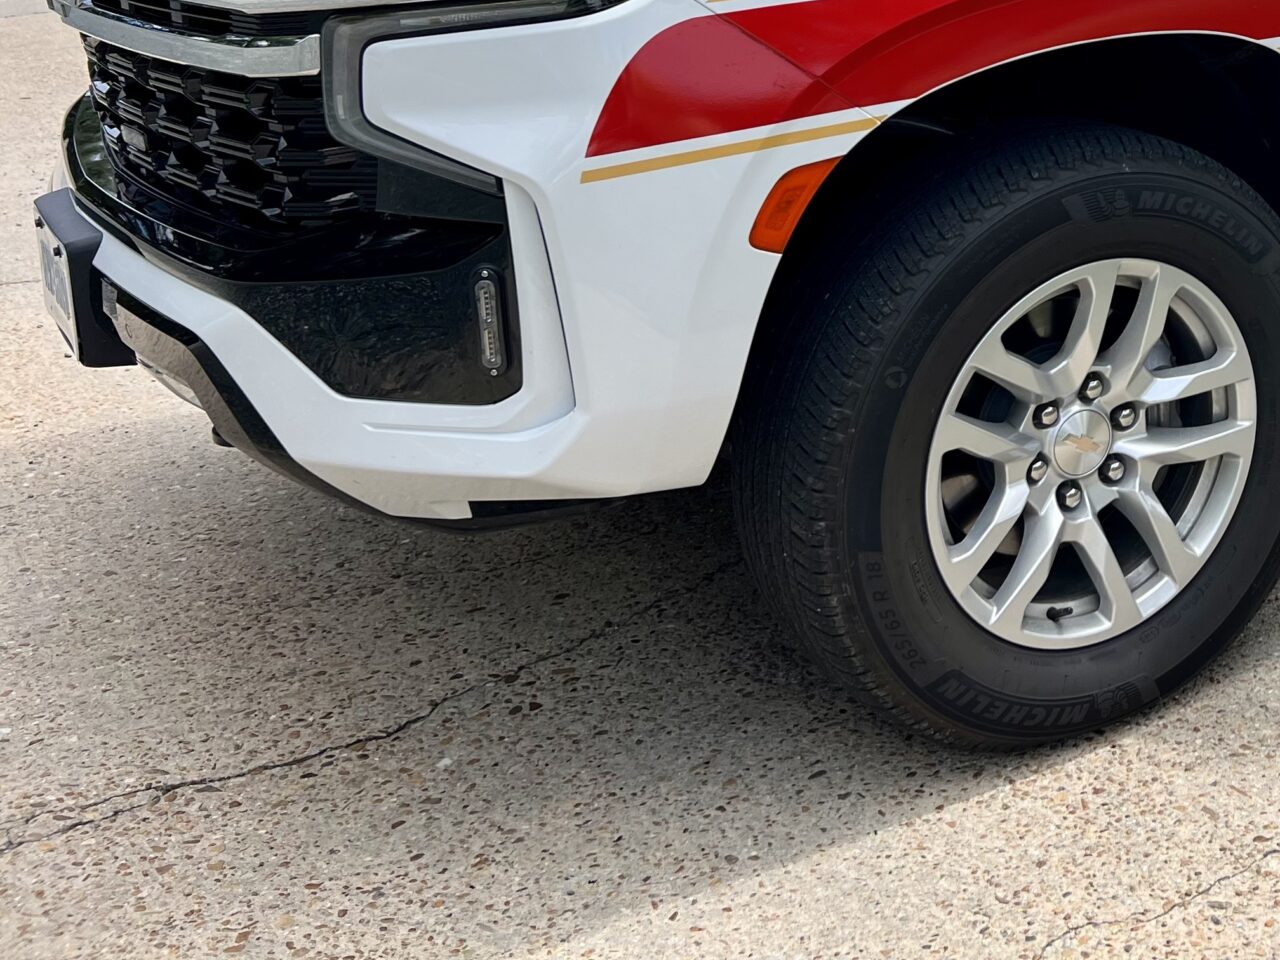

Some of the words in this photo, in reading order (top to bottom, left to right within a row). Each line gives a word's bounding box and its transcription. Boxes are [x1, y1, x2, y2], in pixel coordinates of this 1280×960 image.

[1137, 190, 1265, 256] MICHELIN
[865, 560, 884, 579] 18
[872, 590, 891, 602] R
[879, 608, 928, 669] 265/65
[938, 678, 1090, 726] MICHELIN
